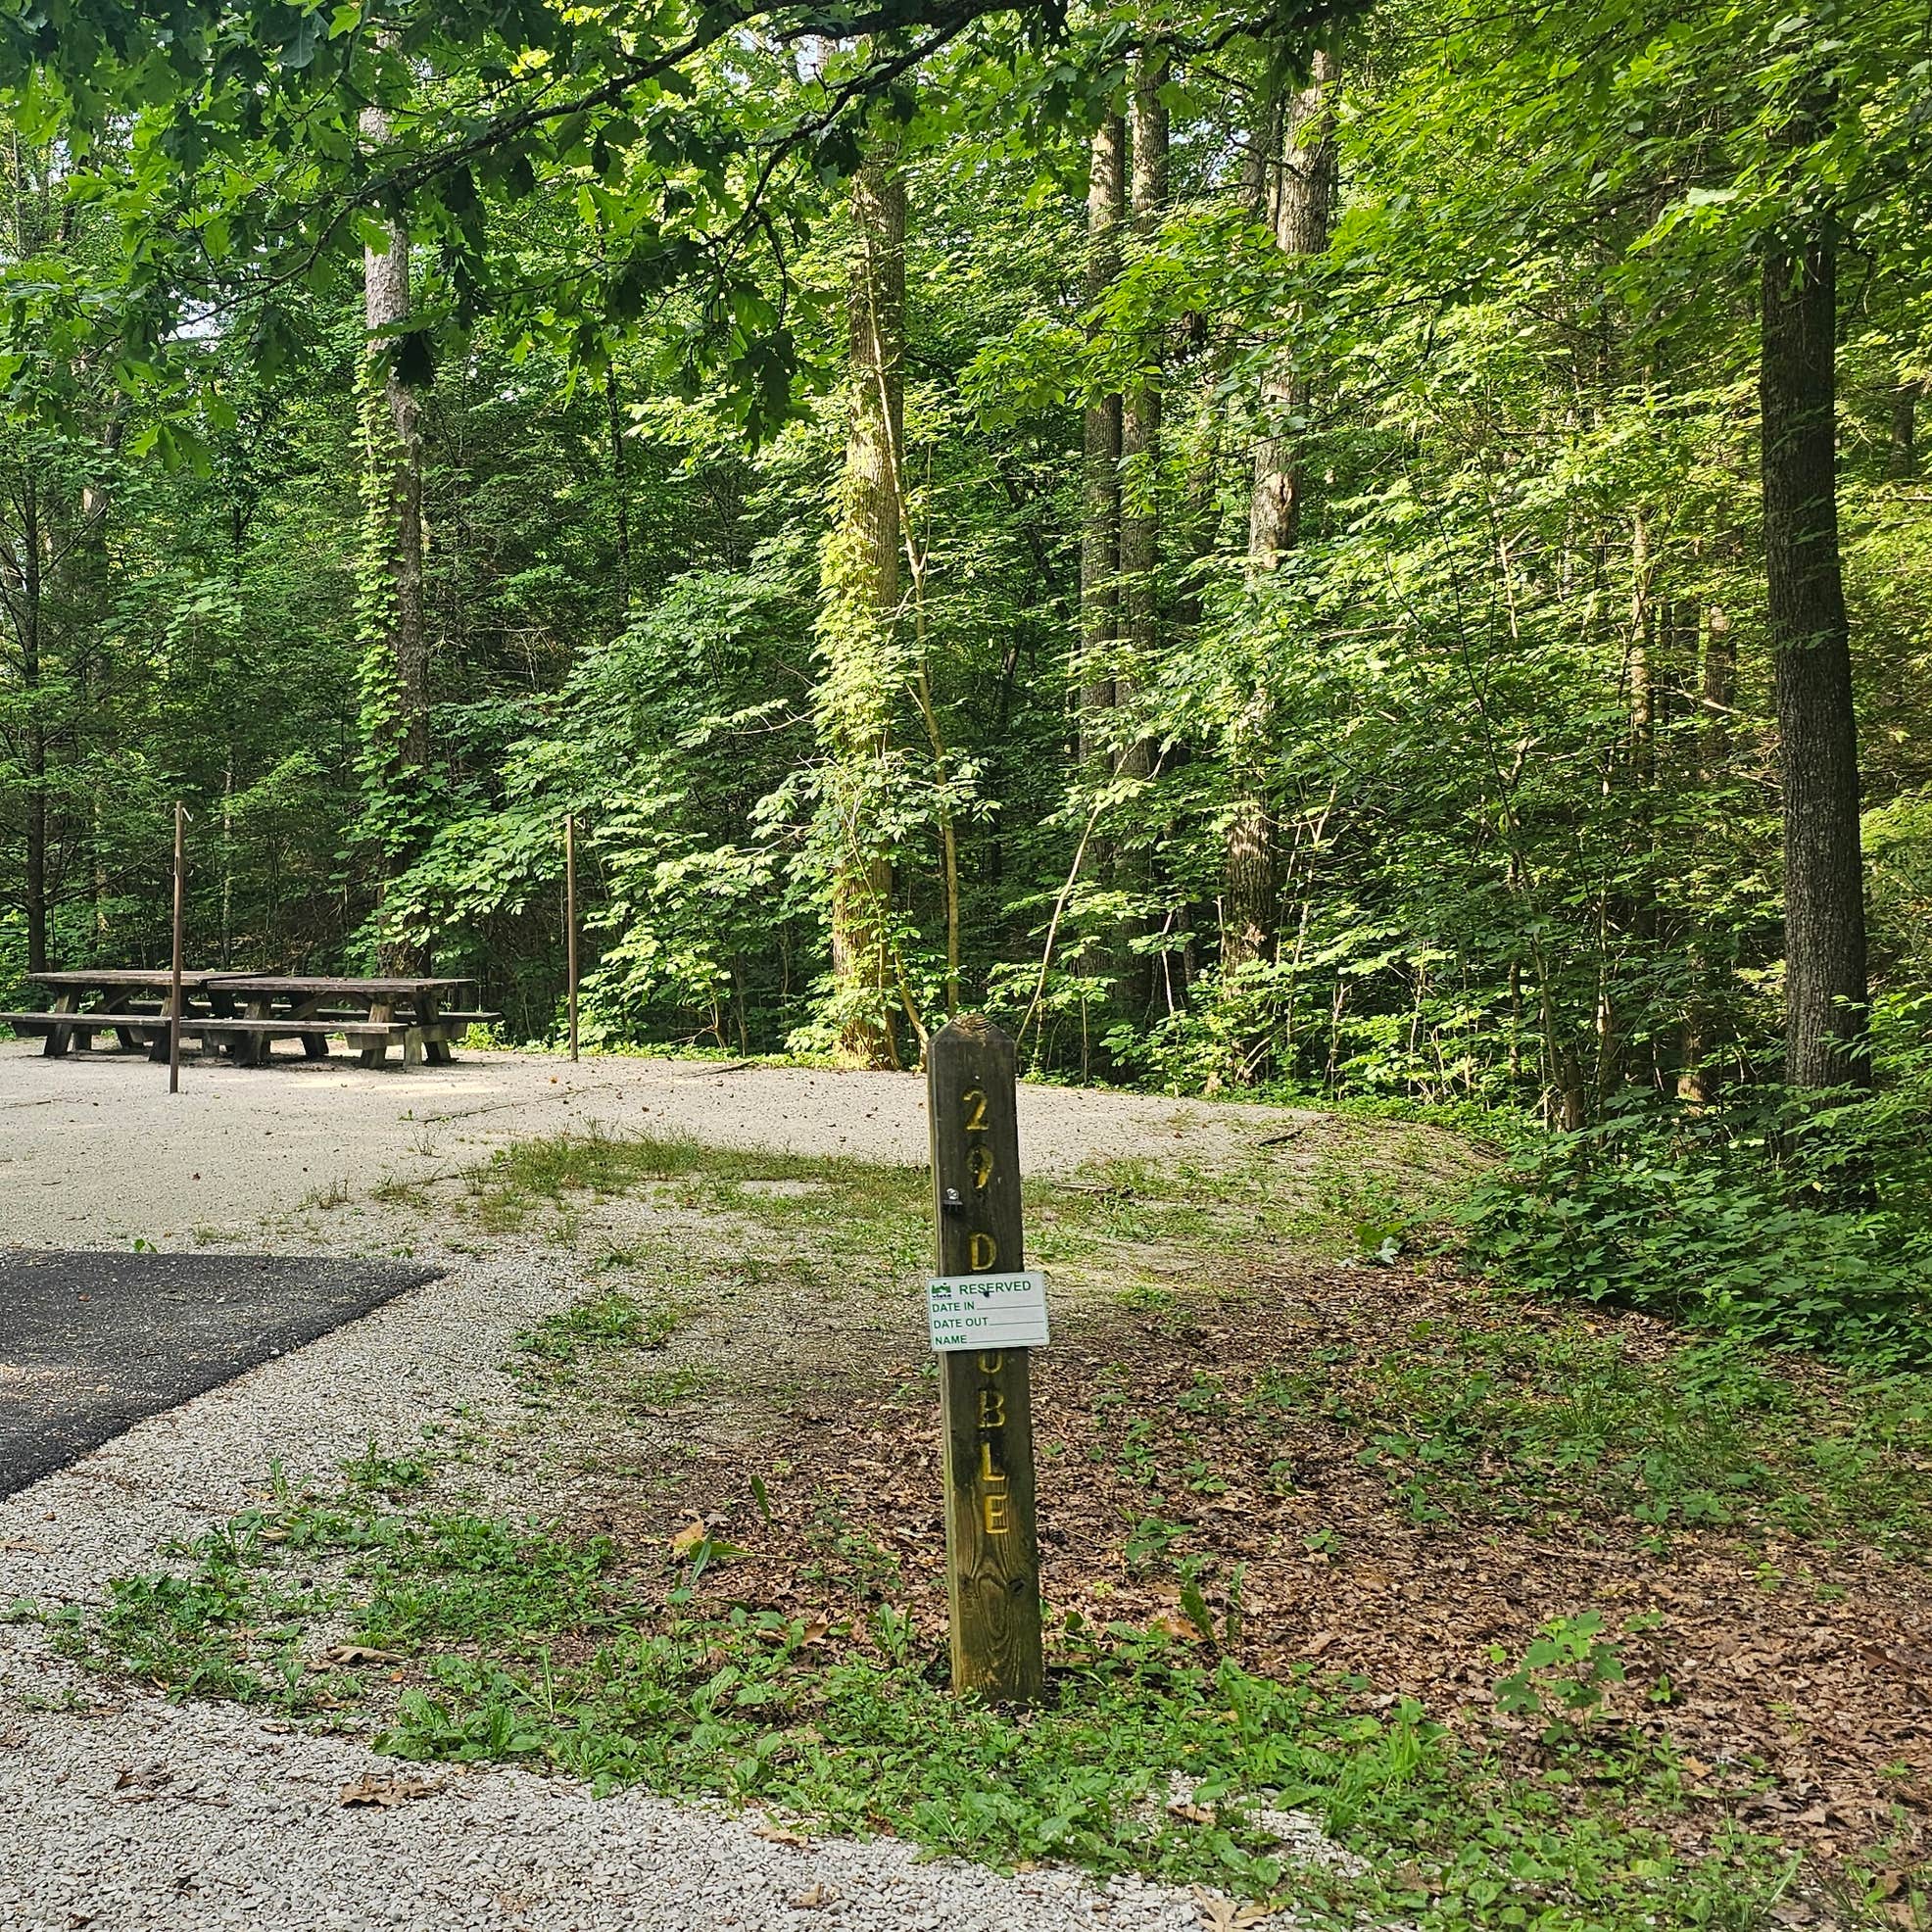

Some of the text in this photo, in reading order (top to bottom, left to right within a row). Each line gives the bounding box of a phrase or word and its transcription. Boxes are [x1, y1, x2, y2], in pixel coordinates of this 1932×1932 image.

[959, 1280, 1032, 1295] RESERVED
[932, 1301, 975, 1313] DATE IN
[962, 1088, 1009, 1534] 29 DUBLE
[934, 1318, 989, 1329] DATE OUT
[935, 1335, 968, 1345] NAME
